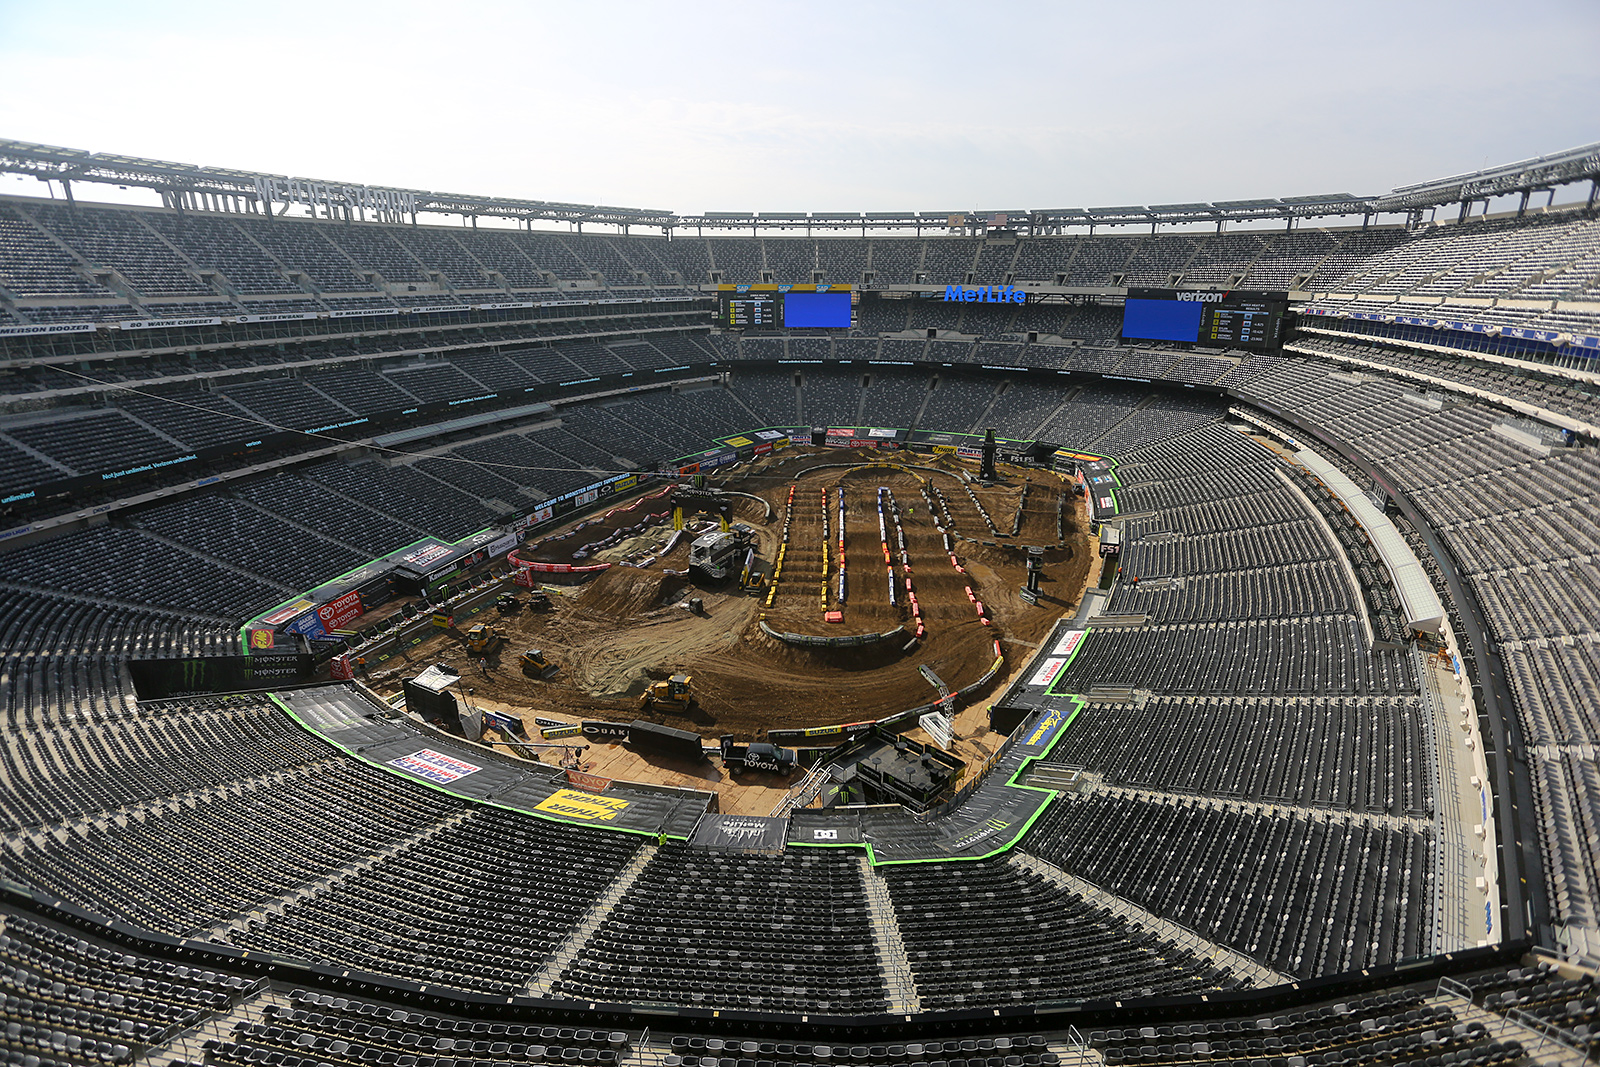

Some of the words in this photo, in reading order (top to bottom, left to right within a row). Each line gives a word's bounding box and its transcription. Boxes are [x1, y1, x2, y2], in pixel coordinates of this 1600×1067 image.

[253, 177, 338, 208] METLIFE
[342, 185, 416, 214] STADIUM
[943, 285, 1026, 304] MetLife
[1176, 290, 1223, 303] verizon
[49, 323, 90, 332] BOOZER
[148, 319, 175, 327] WAYNE
[153, 458, 173, 468] Verizon
[615, 477, 637, 490] SUZUKI
[1, 490, 36, 504] unlimited
[534, 497, 557, 511] WELCOME
[565, 486, 586, 500] MONSTER
[603, 472, 631, 485] SUPERCROSS
[1101, 545, 1119, 553] FS1
[428, 563, 458, 582] Kawasaki
[332, 593, 359, 610] TOYOTA
[337, 608, 359, 623] TOYOTA
[254, 655, 298, 664] MONSTER
[254, 668, 297, 676] MONSTER
[549, 728, 579, 738] SUZUKI
[809, 727, 838, 736] SUZUKI
[402, 757, 459, 779] UNLIMITED
[415, 752, 471, 775] PARTS
[422, 750, 478, 772] UNLIMITED
[743, 758, 779, 772] TOYOTA
[392, 759, 452, 783] PARTS
